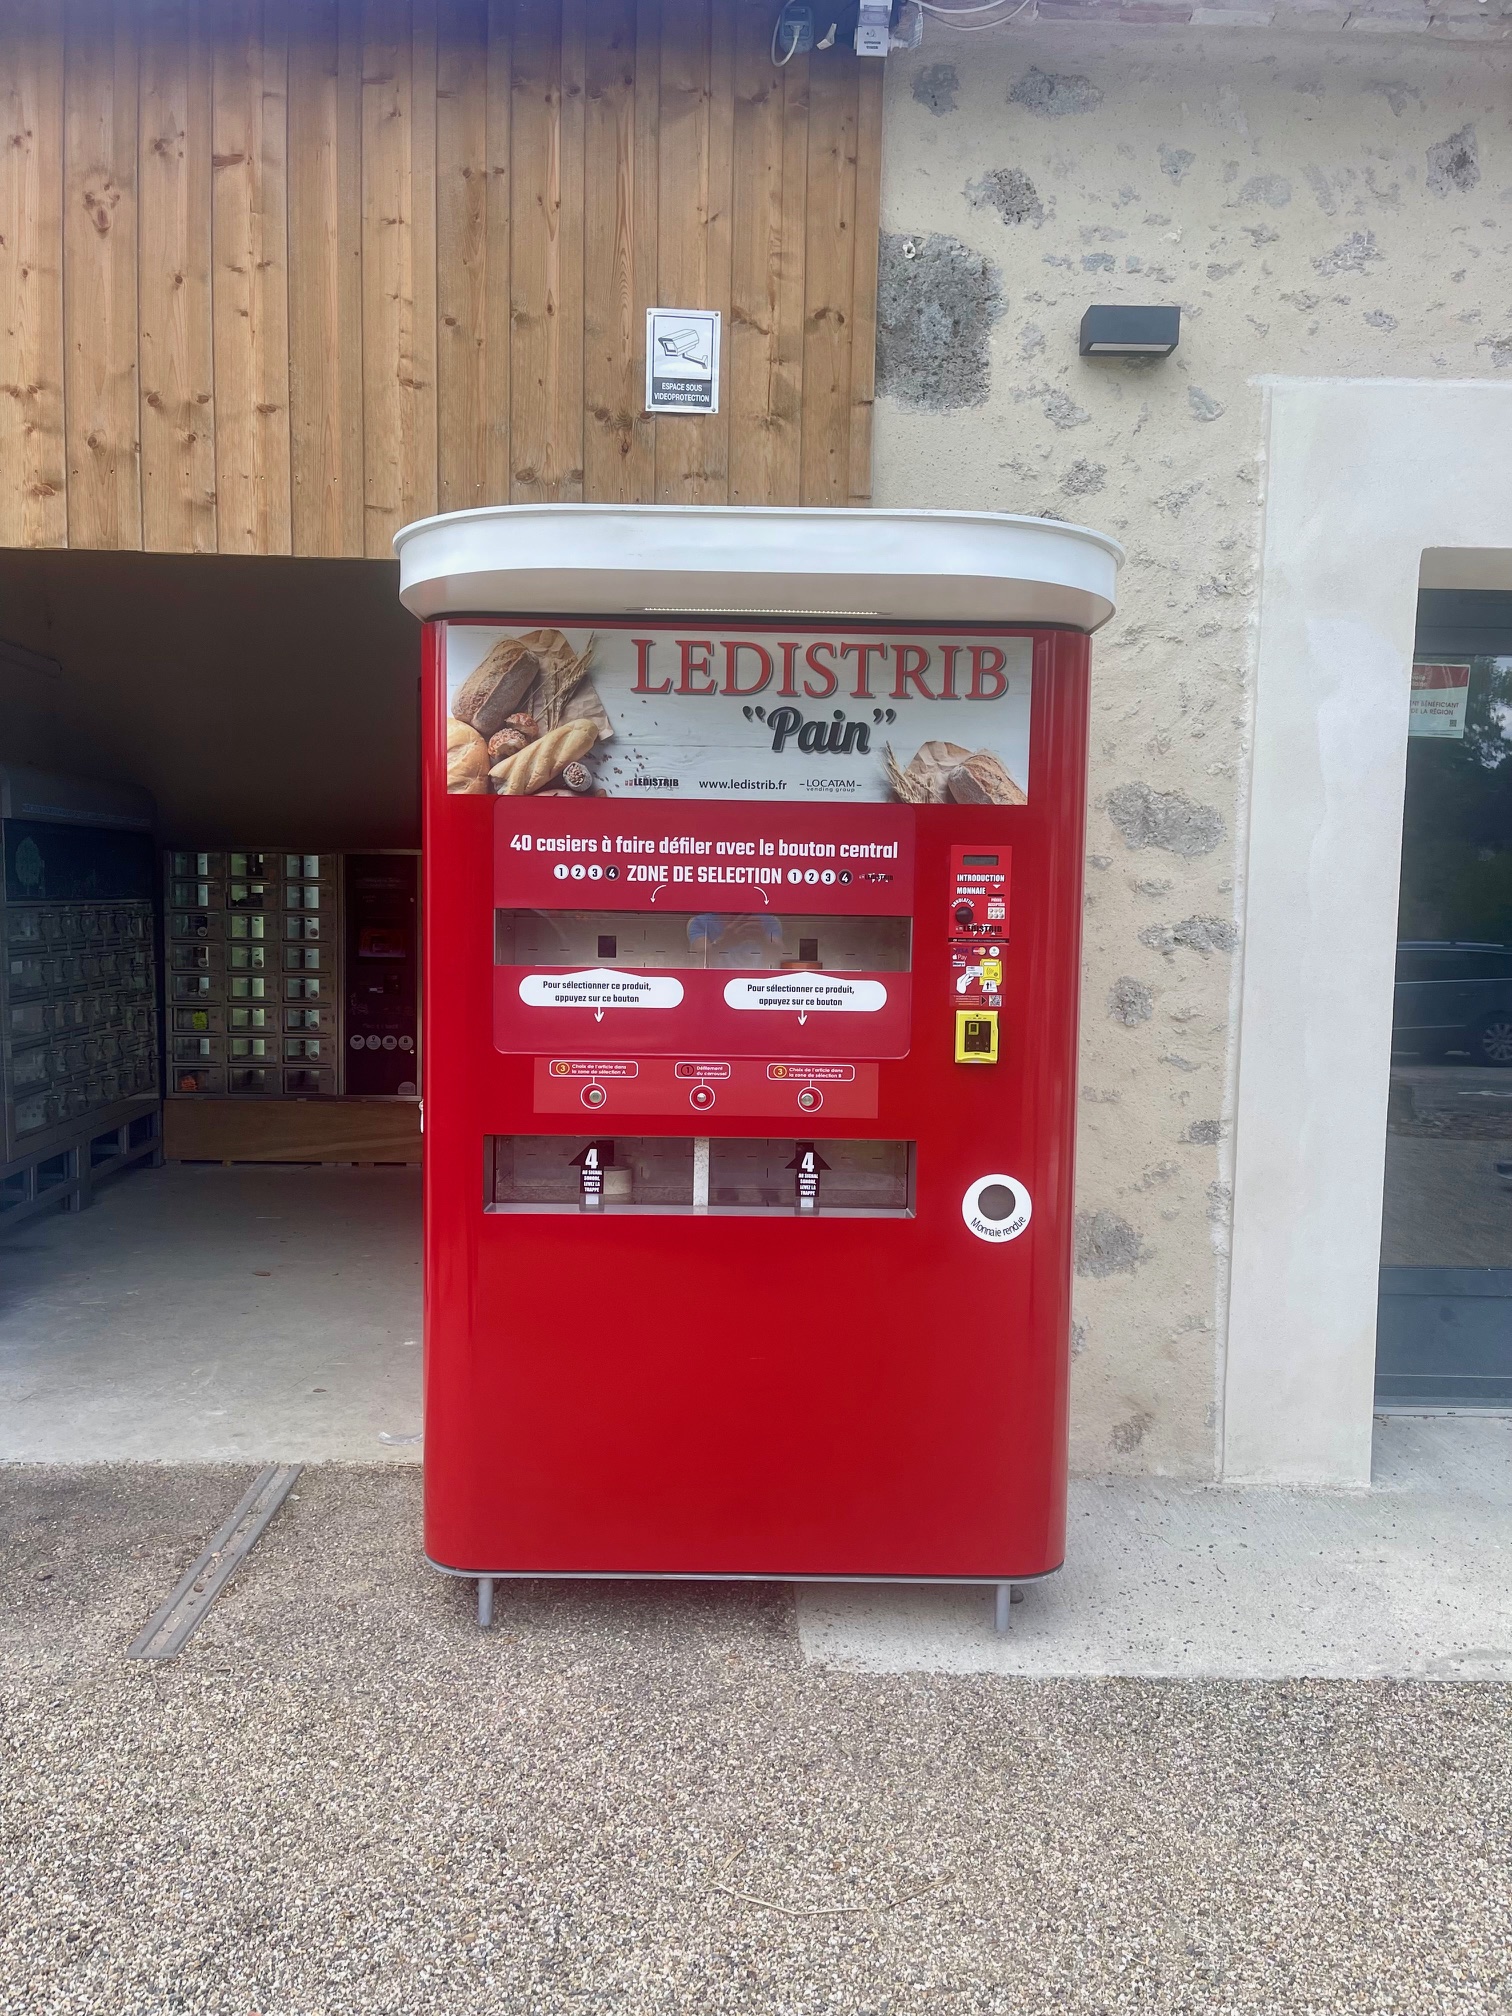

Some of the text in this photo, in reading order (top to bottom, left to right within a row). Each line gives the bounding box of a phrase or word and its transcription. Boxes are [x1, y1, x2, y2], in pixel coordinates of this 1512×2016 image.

[662, 382, 702, 392] ESPACE SOUS
[654, 392, 710, 402] VIDEOPROTECTION
[630, 638, 1008, 700] LEDISTRIB
[634, 778, 679, 787] LEDISTRIB
[699, 779, 787, 790] www.ledistrib.fr
[510, 834, 898, 858] 40 casiers à faire défiler avec le bouton central
[627, 865, 669, 882] ZONE
[673, 866, 694, 882] DE
[698, 866, 782, 884] SELECTION
[543, 980, 560, 988] Pour
[562, 981, 609, 989] sélectionner
[622, 982, 651, 991] produit,
[747, 984, 765, 992] Pour
[766, 984, 813, 993] sélectionner
[825, 985, 854, 994] produit,
[555, 995, 586, 1003] appuyez
[613, 994, 639, 1002] bouton
[759, 998, 790, 1006] appuyez
[816, 998, 842, 1006] bouton
[585, 1149, 598, 1169] 4
[802, 1152, 814, 1172] 4
[970, 1216, 1026, 1237] Monnaie rendue
